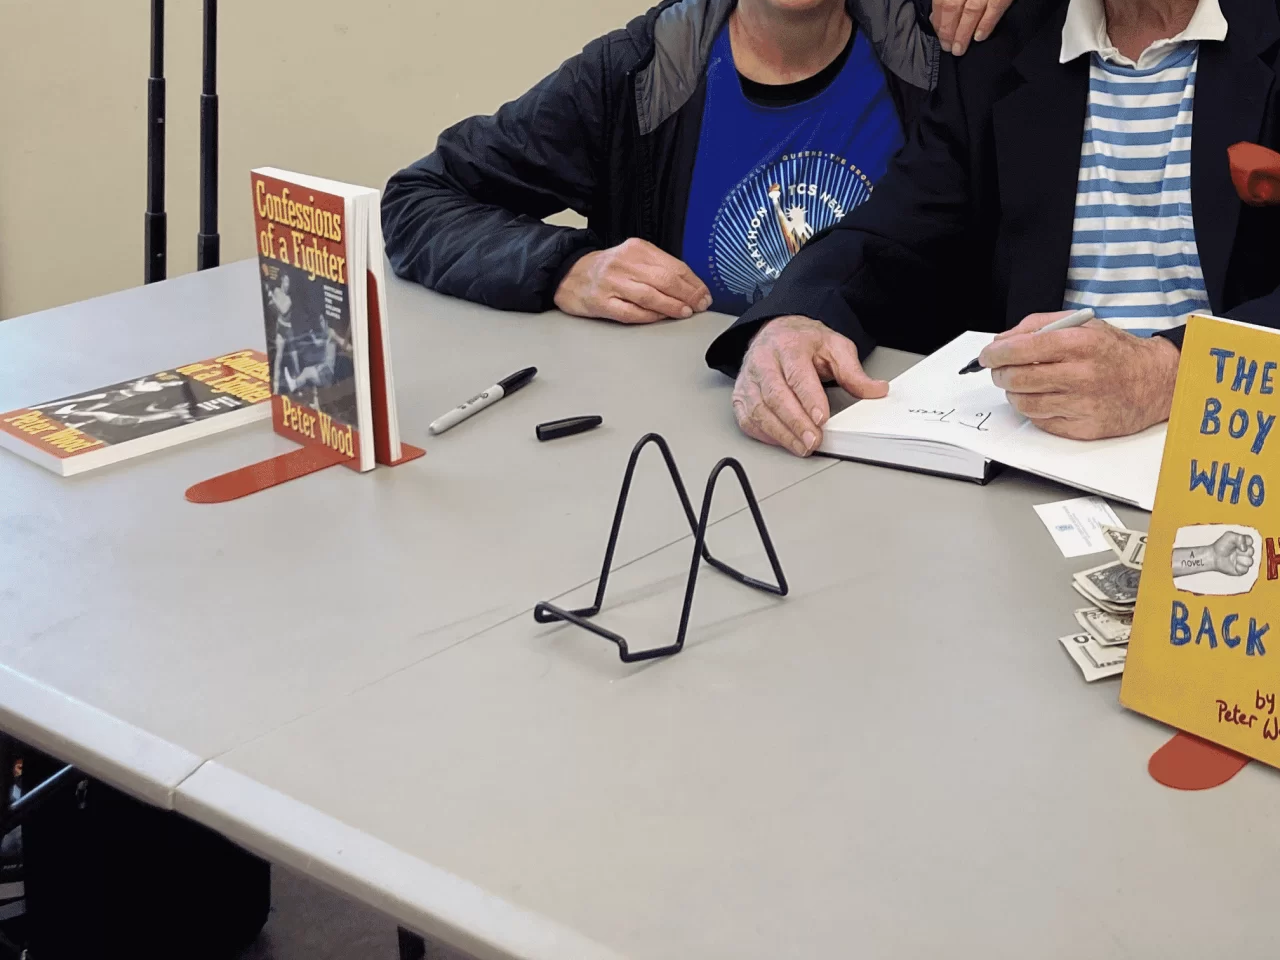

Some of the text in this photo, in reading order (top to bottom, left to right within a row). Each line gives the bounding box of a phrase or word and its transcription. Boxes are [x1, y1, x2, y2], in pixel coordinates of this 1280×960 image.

[256, 179, 342, 242] Confessions
[787, 182, 846, 219] TCS NEW
[260, 222, 277, 259] of
[278, 236, 290, 265] a
[291, 230, 345, 284] Fighter
[1209, 347, 1278, 395] THE
[281, 394, 354, 458] Peter Wood
[1200, 397, 1277, 456] BOY
[1189, 458, 1266, 508] WHO
[1180, 558, 1205, 568] novel
[1189, 550, 1196, 559] A
[1169, 600, 1271, 657] BACK
[1215, 699, 1259, 729] Peter
[1255, 689, 1276, 715] by
